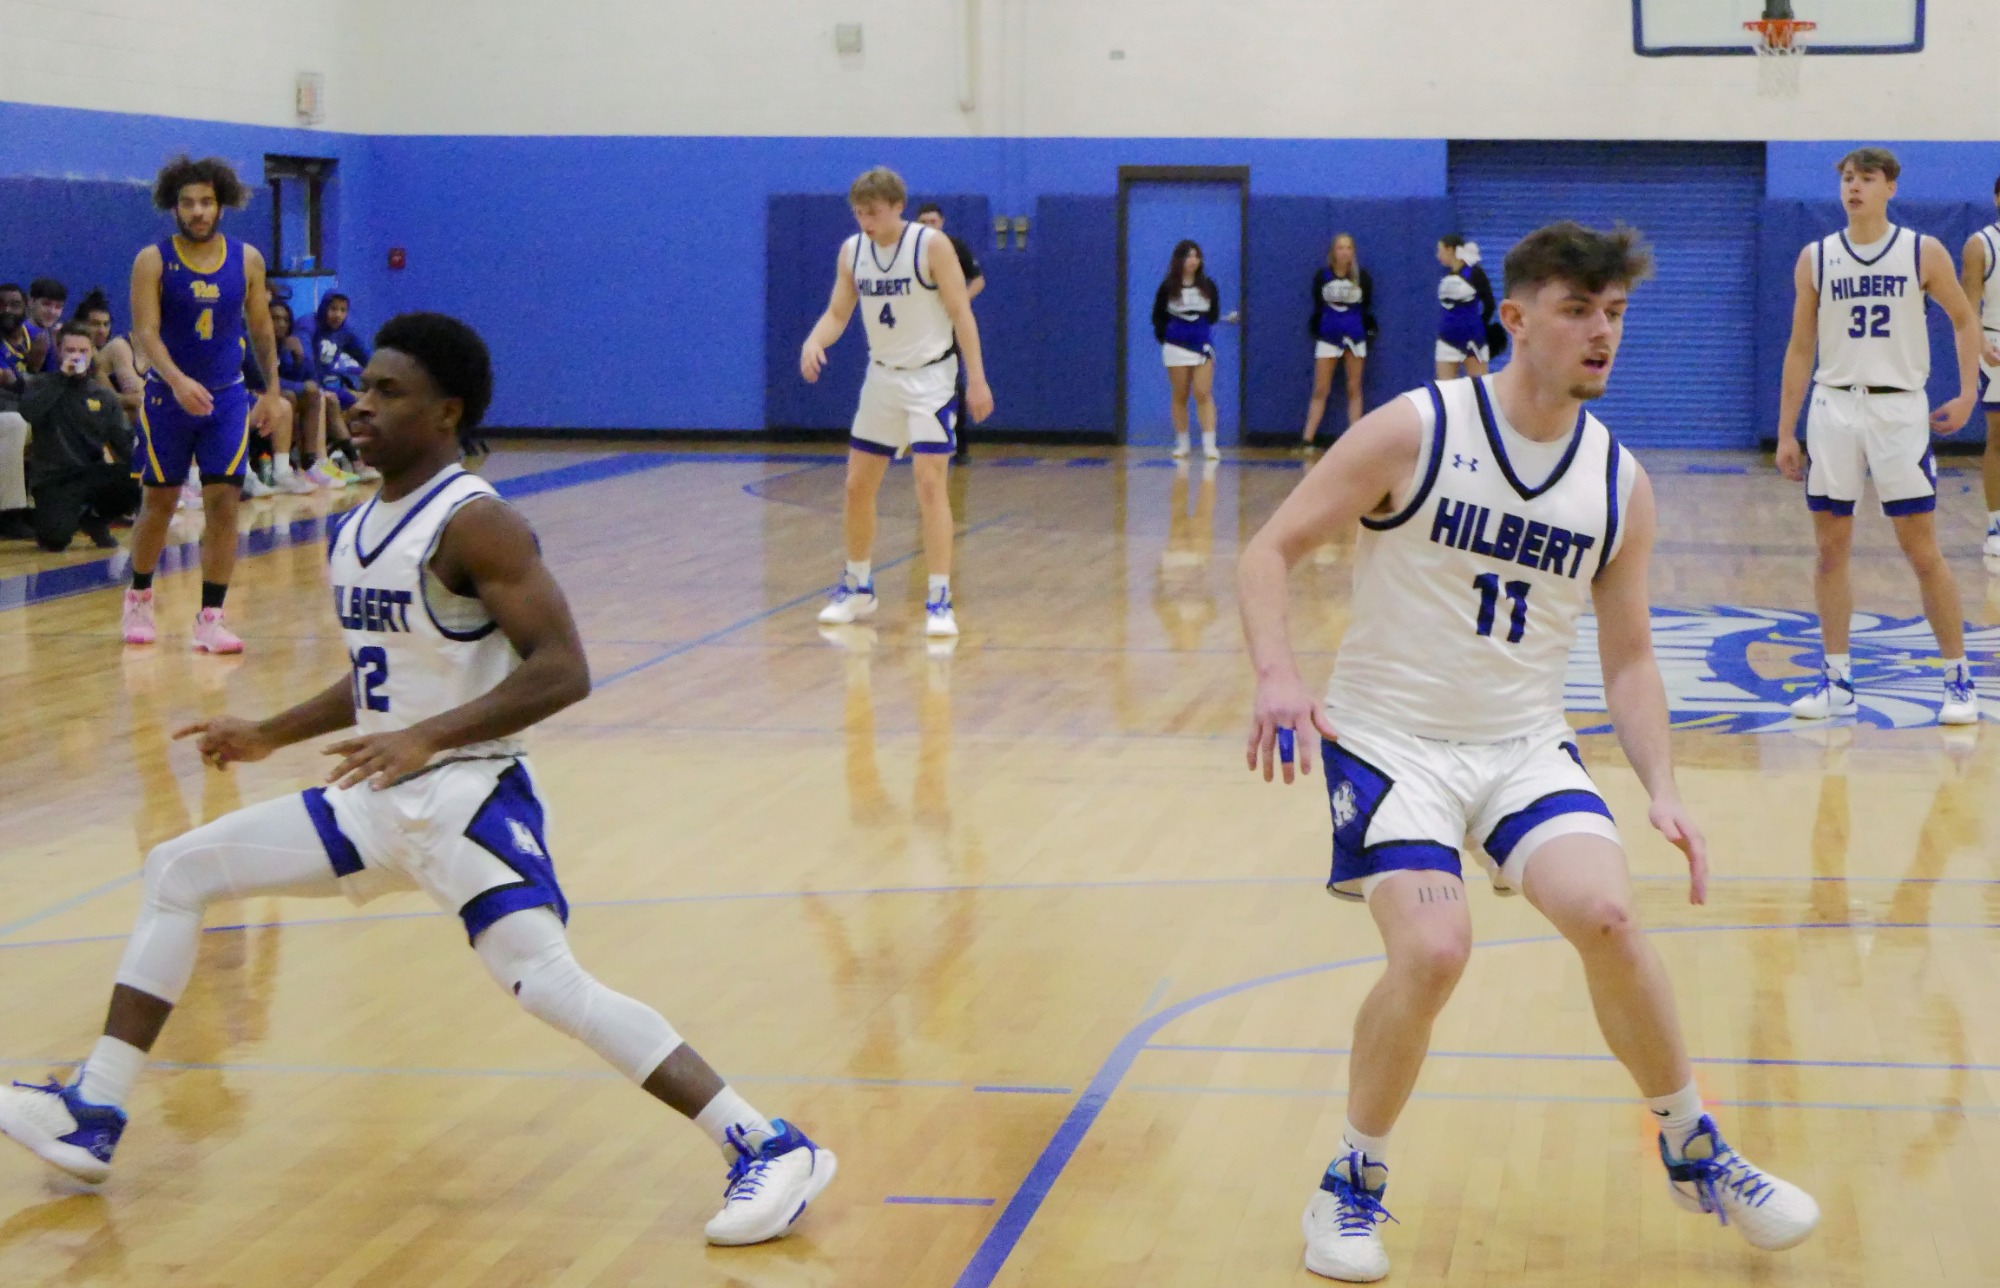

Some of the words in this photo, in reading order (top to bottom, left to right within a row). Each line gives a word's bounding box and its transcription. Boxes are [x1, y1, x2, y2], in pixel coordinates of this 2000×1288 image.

[1831, 275, 1908, 301] HILBERT
[195, 308, 214, 340] 4
[879, 302, 896, 328] 4
[1848, 304, 1890, 338] 32
[1430, 496, 1595, 579] HILBERT
[1473, 572, 1531, 643] 11
